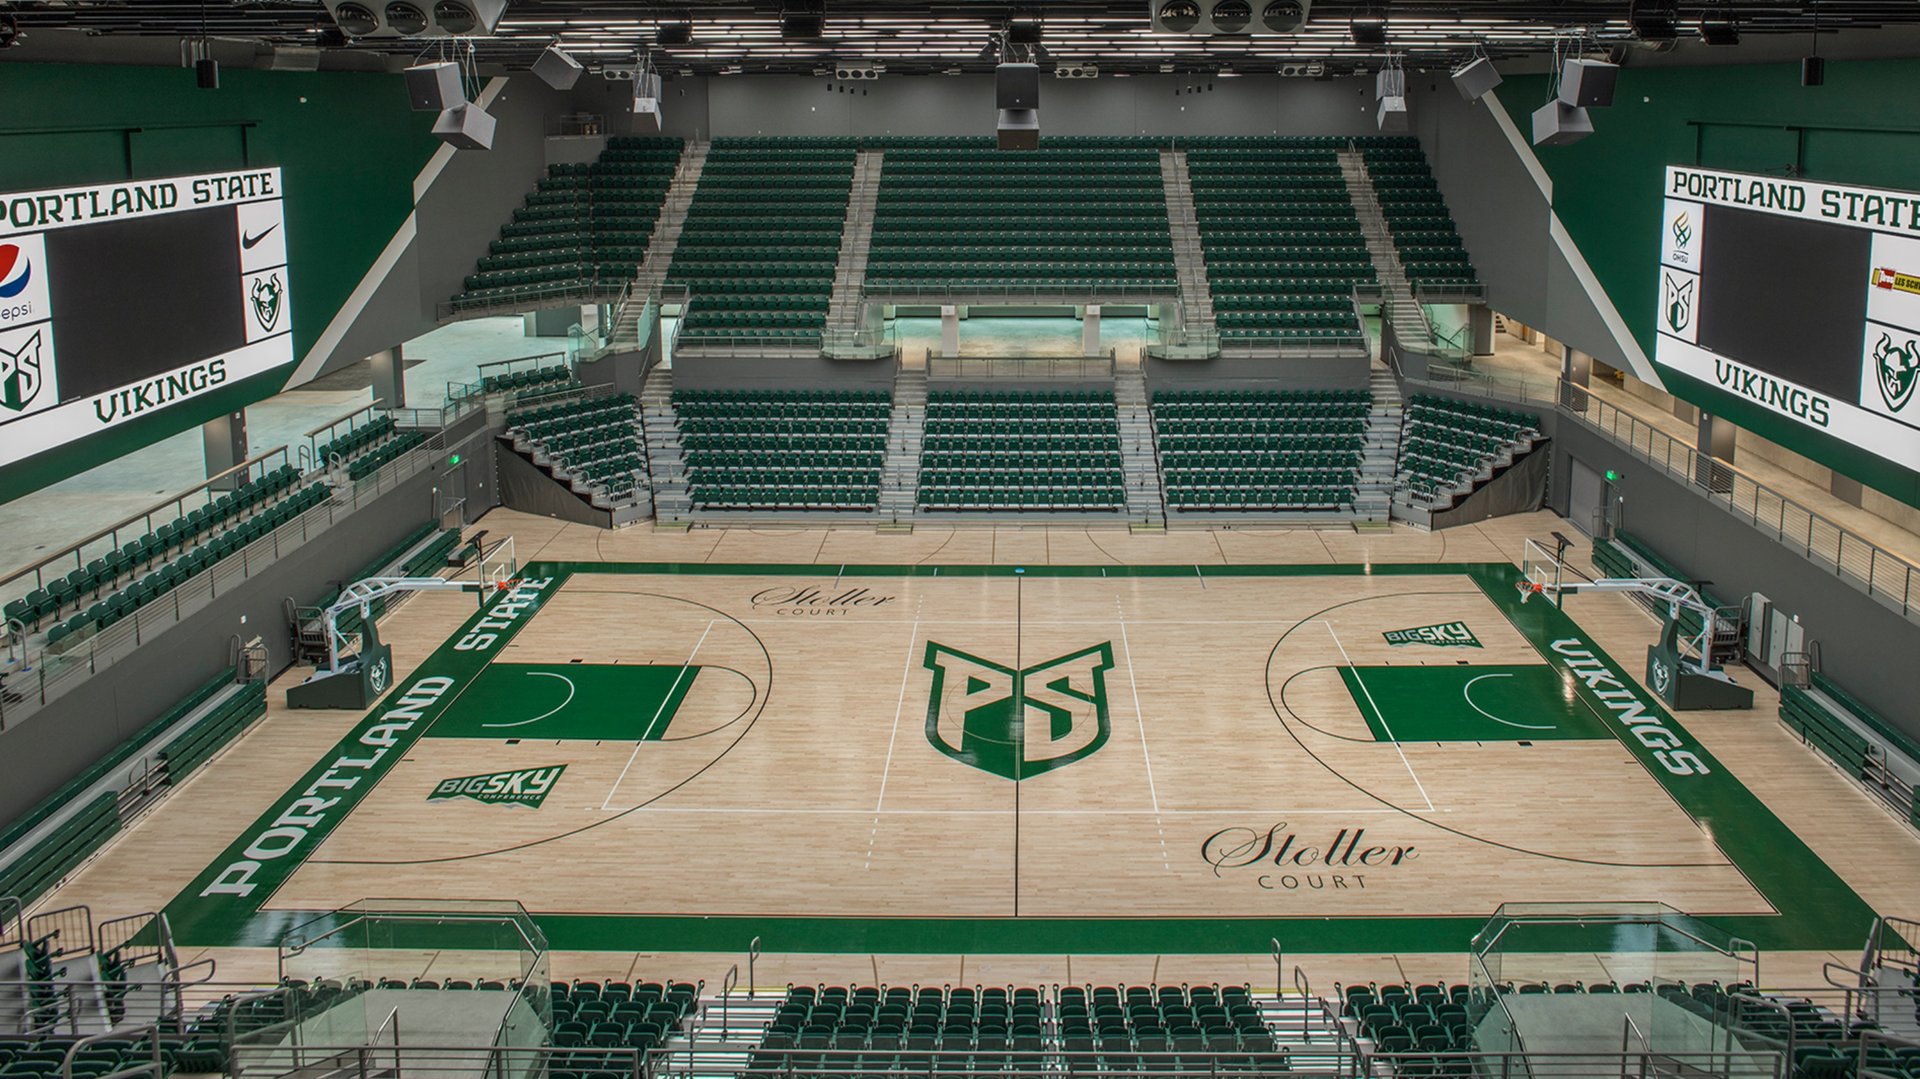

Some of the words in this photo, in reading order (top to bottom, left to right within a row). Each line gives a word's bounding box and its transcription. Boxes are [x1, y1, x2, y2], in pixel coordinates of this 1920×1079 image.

[0, 183, 178, 228] ORTLAND
[192, 172, 274, 204] STATE
[1673, 171, 1806, 213] PORTLAND
[1820, 189, 1920, 231] STATE
[1673, 253, 1689, 264] OHSU
[1905, 278, 1920, 291] SCH
[0, 301, 32, 321] epsi
[93, 358, 227, 424] VIKINGS
[1715, 358, 1830, 428] VIKINGS
[453, 576, 553, 651] STATE
[750, 585, 896, 610] Stoller
[776, 608, 849, 616] COURT
[1550, 637, 1711, 776] VIKINGS
[199, 676, 455, 898] PORTLAND
[1201, 821, 1420, 878] Stoller
[1258, 874, 1366, 889] COURT
